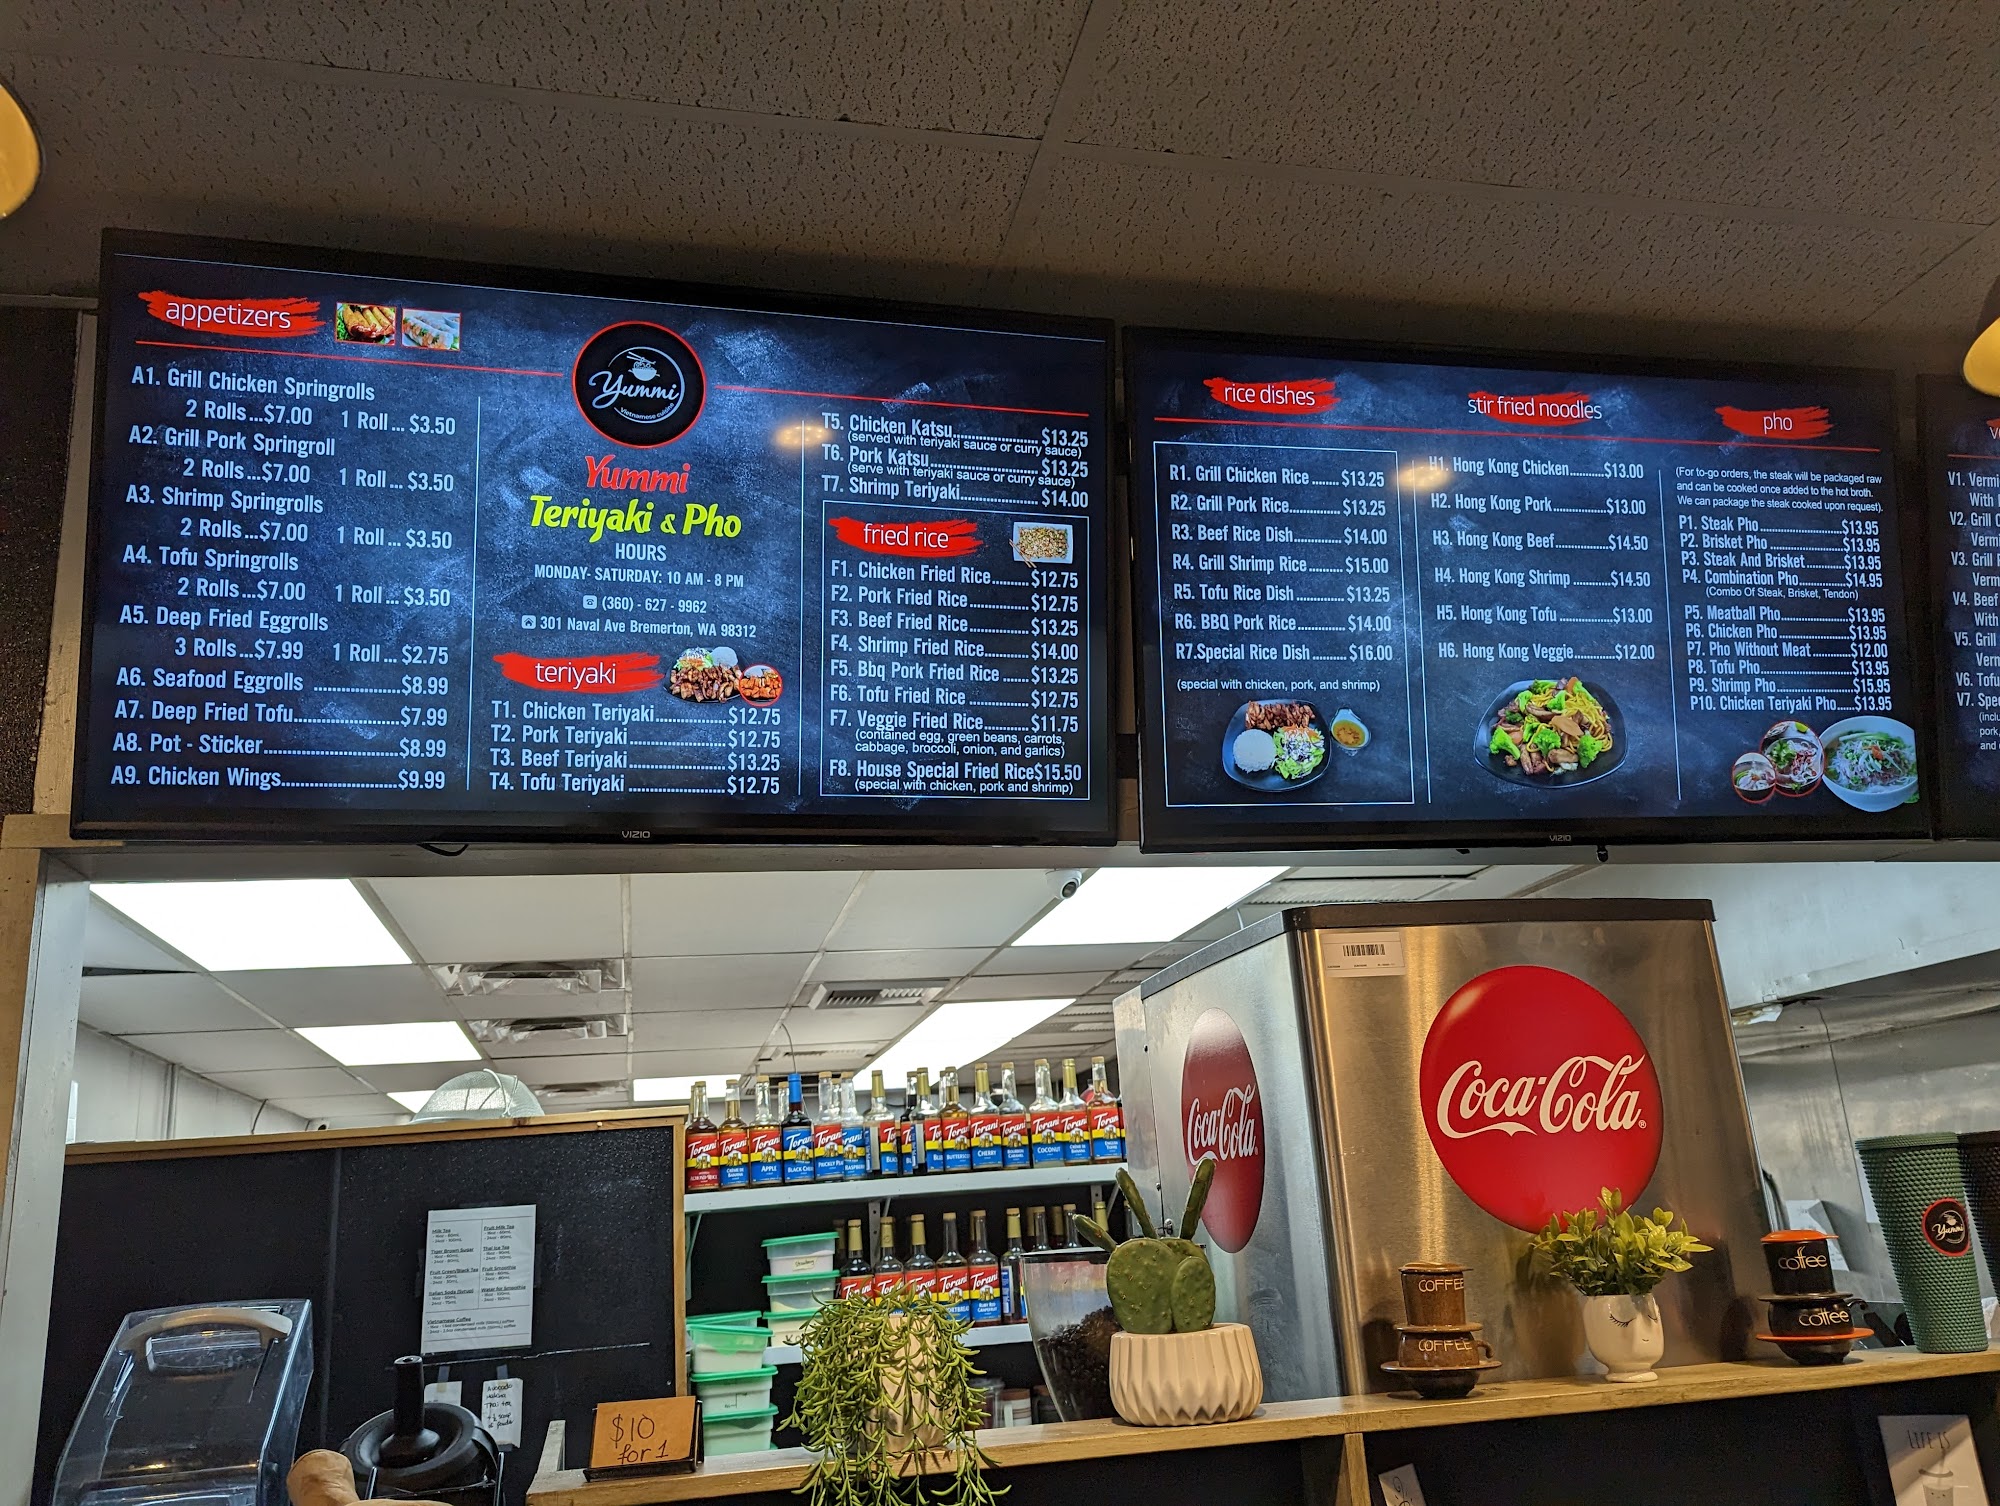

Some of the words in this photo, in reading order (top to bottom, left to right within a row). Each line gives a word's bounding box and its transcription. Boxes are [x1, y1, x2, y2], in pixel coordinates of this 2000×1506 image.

[165, 300, 291, 329] appetizers
[132, 366, 160, 386] A1.
[167, 369, 202, 388] Grill
[209, 371, 277, 393] Chicken
[284, 377, 375, 402] Springrolls
[588, 370, 679, 409] Yummi
[1224, 386, 1255, 403] rice
[1260, 386, 1315, 406] dishes
[620, 406, 656, 420] Vietnamese
[1468, 396, 1494, 415] stir
[1497, 396, 1534, 416] fried
[1540, 400, 1602, 419] noodles
[822, 412, 844, 430] T5.
[850, 414, 905, 434] Chicken
[1041, 427, 1088, 447] $13.25
[1763, 413, 1792, 434] pho
[848, 431, 890, 445] (served
[893, 433, 918, 447] with
[920, 434, 961, 449] teriyaki
[963, 438, 997, 451] sauce
[1000, 441, 1011, 452] or
[1014, 441, 1042, 457] curry
[1044, 443, 1082, 458] sauce)
[585, 454, 691, 494] Yummi
[1170, 464, 1191, 481] R1.
[1196, 466, 1221, 481] Grill
[1226, 467, 1277, 484] Chicken
[1282, 469, 1309, 484] Rice
[1341, 469, 1384, 487] $13.25
[1676, 467, 1694, 477] (For
[1697, 468, 1719, 479] to-go
[1721, 469, 1751, 480] orders,
[1753, 470, 1767, 480] the
[1769, 471, 1793, 480] steak
[1794, 472, 1808, 481] will
[1810, 472, 1821, 481] be
[1824, 473, 1864, 485] packaged
[1867, 474, 1882, 483] raw
[126, 485, 154, 504] A3.
[162, 487, 224, 510] Shrimp
[231, 491, 323, 515] Springrolls
[530, 495, 655, 542] Teriyaki
[661, 514, 676, 535] &
[682, 503, 741, 538] Pho
[863, 523, 908, 546] fried
[915, 527, 948, 548] rice
[616, 544, 667, 561] HOURS
[595, 568, 663, 584] SATURDAY:
[667, 571, 680, 585] 10
[687, 572, 703, 586] AM
[715, 573, 722, 586] 8
[726, 573, 743, 587] PM
[1435, 568, 1454, 583] H4.
[1459, 569, 1490, 586] Hong
[1495, 570, 1525, 587] Kong
[1529, 570, 1570, 588] Shrimp
[1706, 587, 1742, 597] (Combo
[1744, 587, 1756, 597] Of
[1758, 588, 1785, 598] Steak,
[1788, 589, 1821, 598] Brisket,
[1823, 589, 1858, 600] Tendon)
[1953, 592, 1969, 606] V4.
[1974, 592, 1998, 606] Beef
[601, 596, 634, 612] (360)
[645, 598, 667, 611] 627
[679, 600, 707, 614] 9962
[119, 605, 149, 624] A5.
[156, 607, 201, 629] Deep
[209, 609, 252, 628] Fried
[259, 612, 328, 634] Eggrolls
[540, 616, 562, 630] 301
[567, 618, 600, 632] Naval
[605, 620, 626, 633] Ave
[630, 620, 693, 637] Bremerton,
[698, 624, 716, 636] WA
[721, 624, 756, 638] 98312
[1954, 632, 1971, 646] V5.
[1975, 632, 1996, 646] Grill
[116, 667, 146, 686] A6.
[153, 668, 227, 688] Seafood
[234, 671, 303, 694] Eggrolls
[535, 662, 616, 689] teriyaki
[831, 660, 851, 677] F5.
[858, 661, 885, 680] Bbq
[891, 662, 924, 680] Pork
[929, 663, 964, 681] Fried
[970, 664, 999, 682] Rice
[1031, 666, 1078, 685] $13.25
[1177, 678, 1218, 690] (special
[1221, 680, 1242, 689] with
[1245, 680, 1287, 691] chicken,
[1291, 681, 1317, 691] pork,
[1320, 680, 1338, 690] and
[1341, 680, 1380, 691] shrimp)
[855, 729, 916, 742] (contained
[919, 732, 944, 744] egg,
[948, 732, 980, 744] green
[983, 732, 1021, 745] beans,
[1024, 733, 1065, 746] carrots,
[1437, 1054, 1646, 1139] Coca-Cola
[972, 1120, 998, 1138] Torani
[1001, 1120, 1025, 1140] Torani
[1033, 1117, 1059, 1135] Torani
[1187, 1083, 1256, 1164] Coca-Cola
[688, 1140, 716, 1159] Torani
[720, 1137, 747, 1157] Torani
[1778, 1246, 1827, 1270] coffee
[940, 1274, 967, 1294] Torani
[970, 1271, 998, 1290] Torani
[1419, 1278, 1464, 1292] COFFEE
[1419, 1340, 1472, 1351] COFFEE
[610, 1414, 654, 1449] $10
[618, 1443, 651, 1464] for
[656, 1440, 668, 1459] 1
